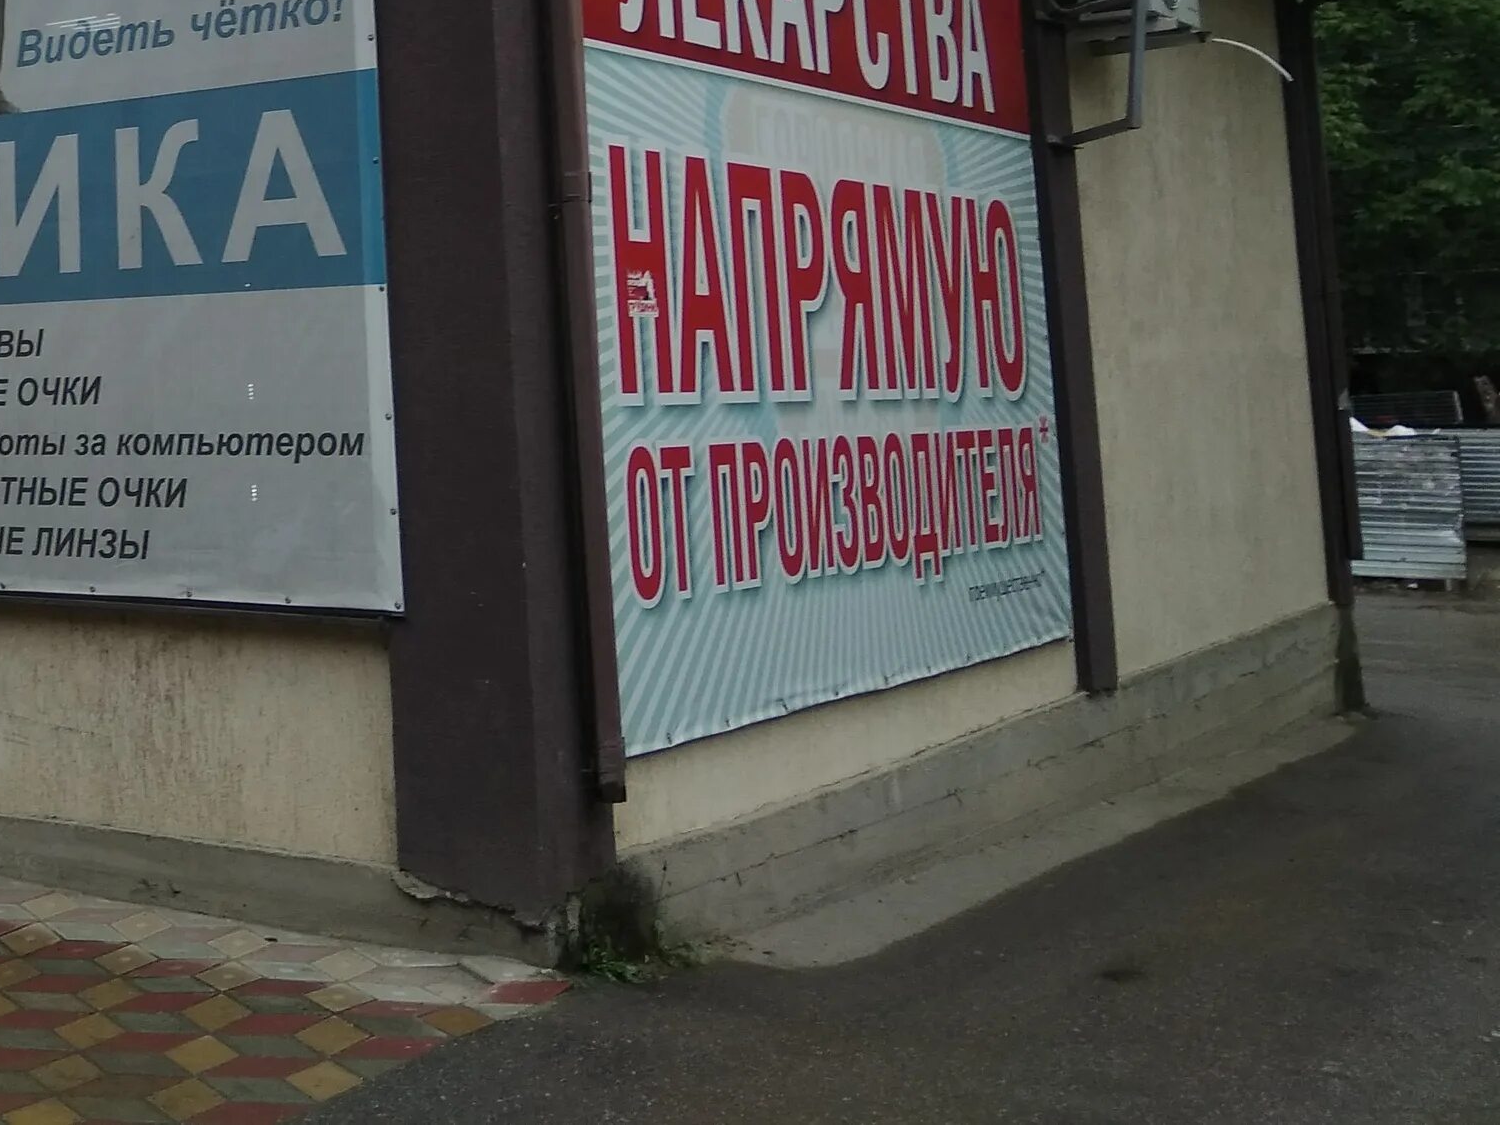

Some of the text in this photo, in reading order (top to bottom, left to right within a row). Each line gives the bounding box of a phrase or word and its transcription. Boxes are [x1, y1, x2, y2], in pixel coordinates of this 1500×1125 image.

[16, 19, 176, 68] Видеть
[606, 143, 1027, 401] НАПРЯМУЮ
[17, 376, 102, 407] ОЧКИ
[73, 433, 107, 457] за
[116, 429, 365, 464] компьютером
[97, 476, 188, 509] ОЧКИ
[626, 442, 693, 606] ОТ
[31, 526, 150, 561] ЛИНЗЫ
